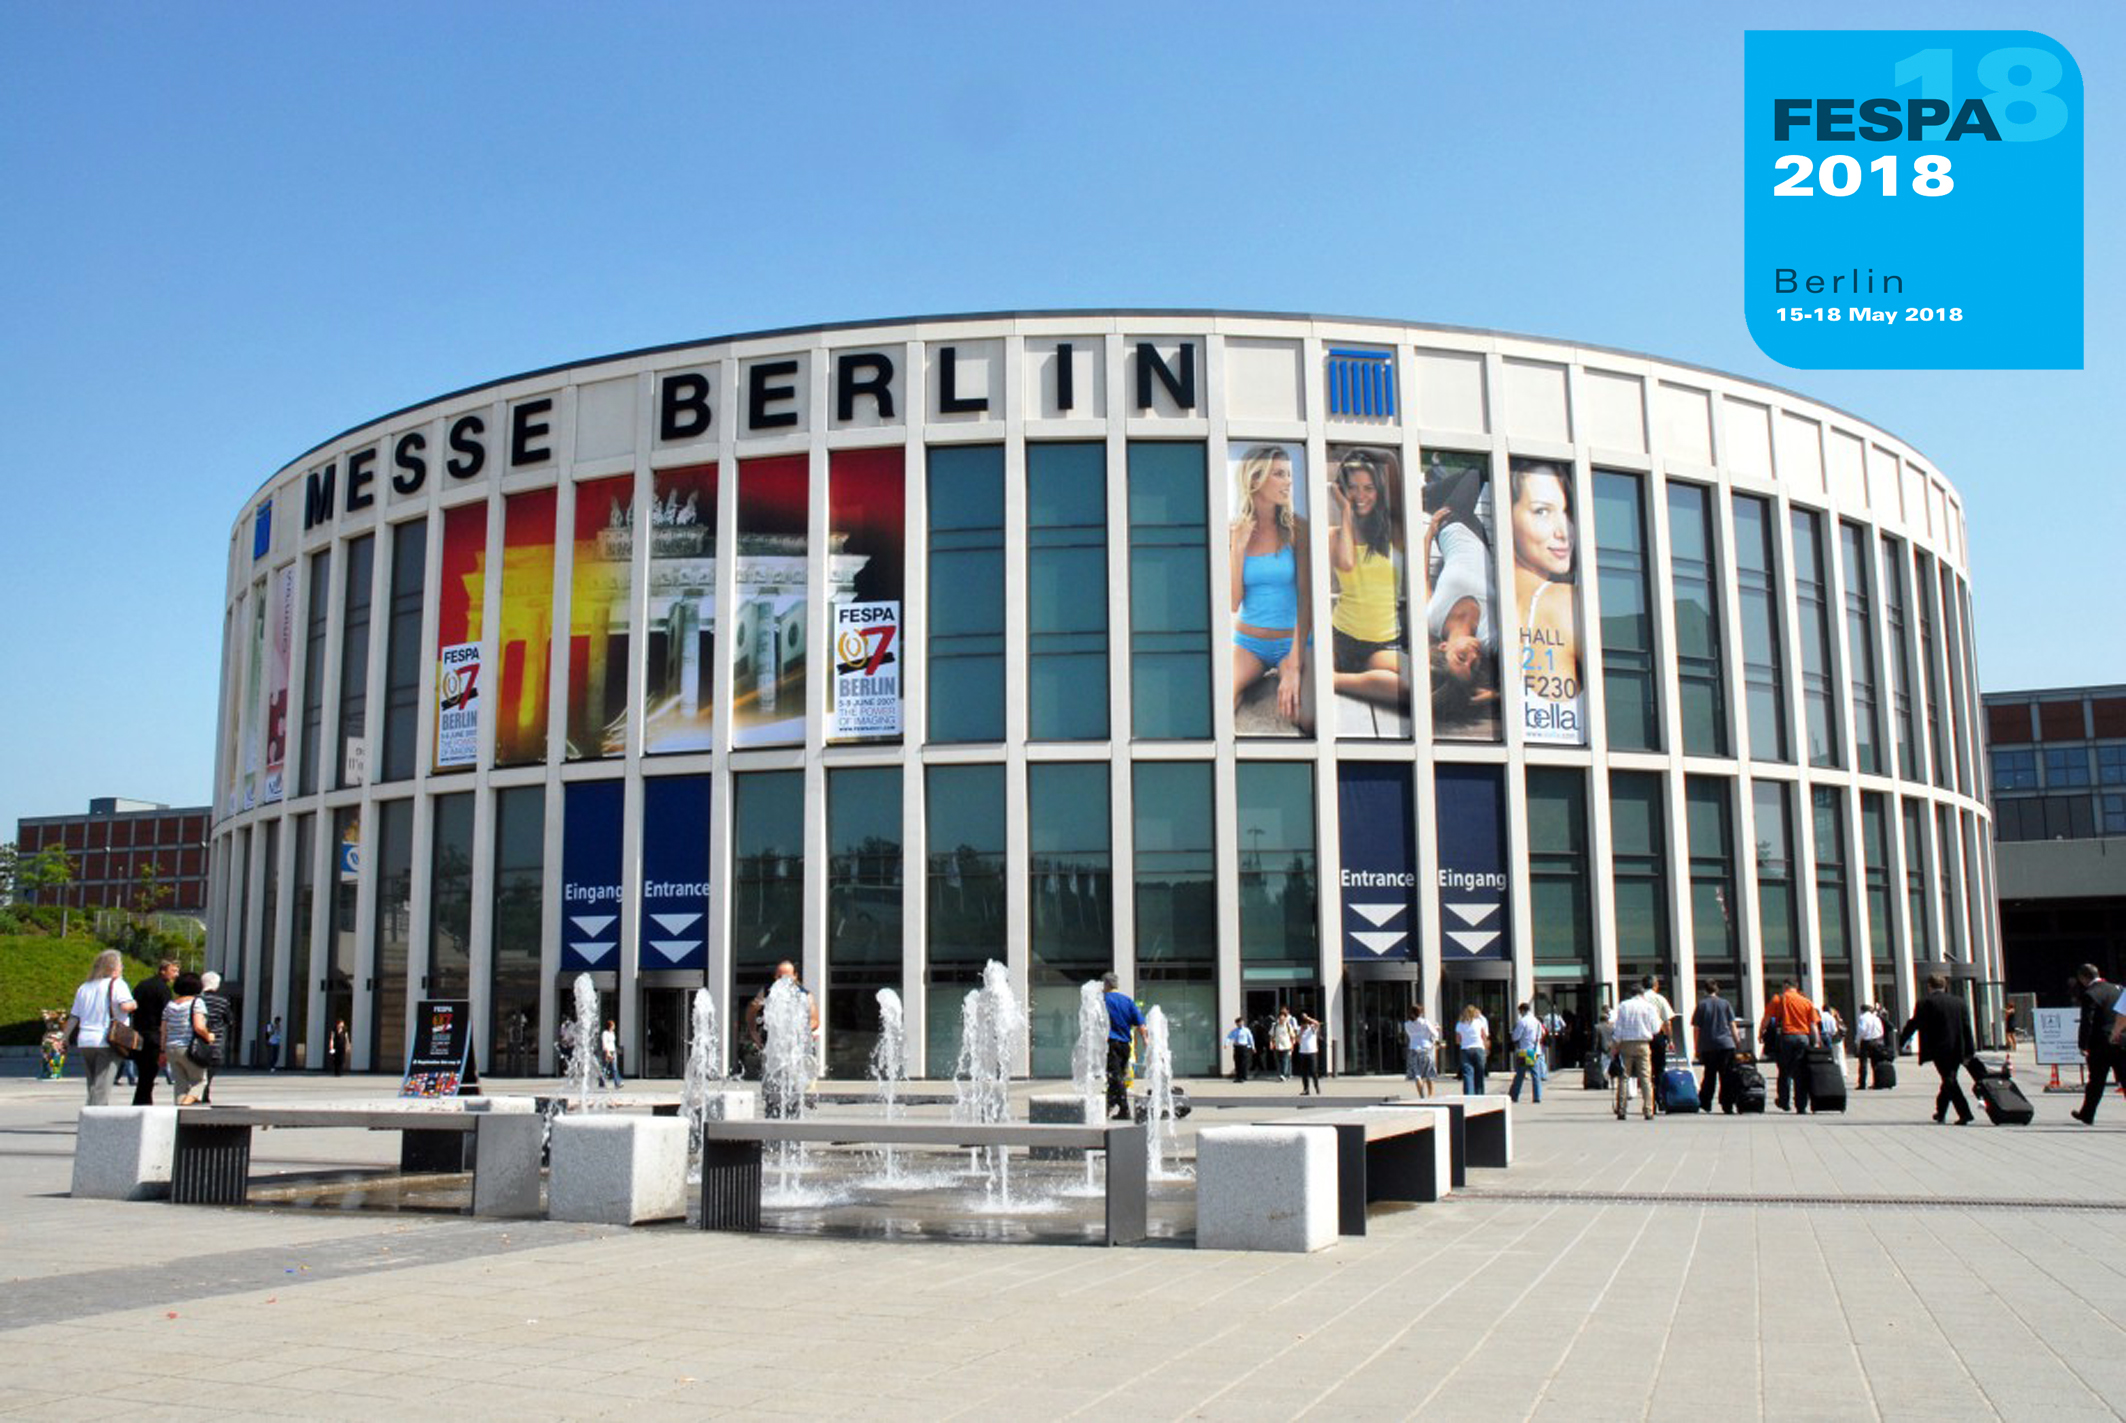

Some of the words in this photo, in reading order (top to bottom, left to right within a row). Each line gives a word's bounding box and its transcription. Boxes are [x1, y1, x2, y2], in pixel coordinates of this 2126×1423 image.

[304, 397, 552, 530] MESSE
[660, 342, 1196, 441] BERLIN
[839, 607, 895, 623] FESPA
[1520, 627, 1564, 646] HALL
[444, 647, 479, 664] FESPA
[1522, 646, 1555, 672] 2.1
[839, 676, 897, 698] BERLIN
[1523, 674, 1578, 700] F230
[853, 698, 876, 707] JUNE
[442, 710, 477, 730] BERLIN
[1524, 701, 1581, 731] bella
[1340, 869, 1415, 888] Entrance
[1438, 868, 1508, 892] Eingang
[565, 883, 623, 903] Eingang
[644, 880, 711, 897] Entrance
